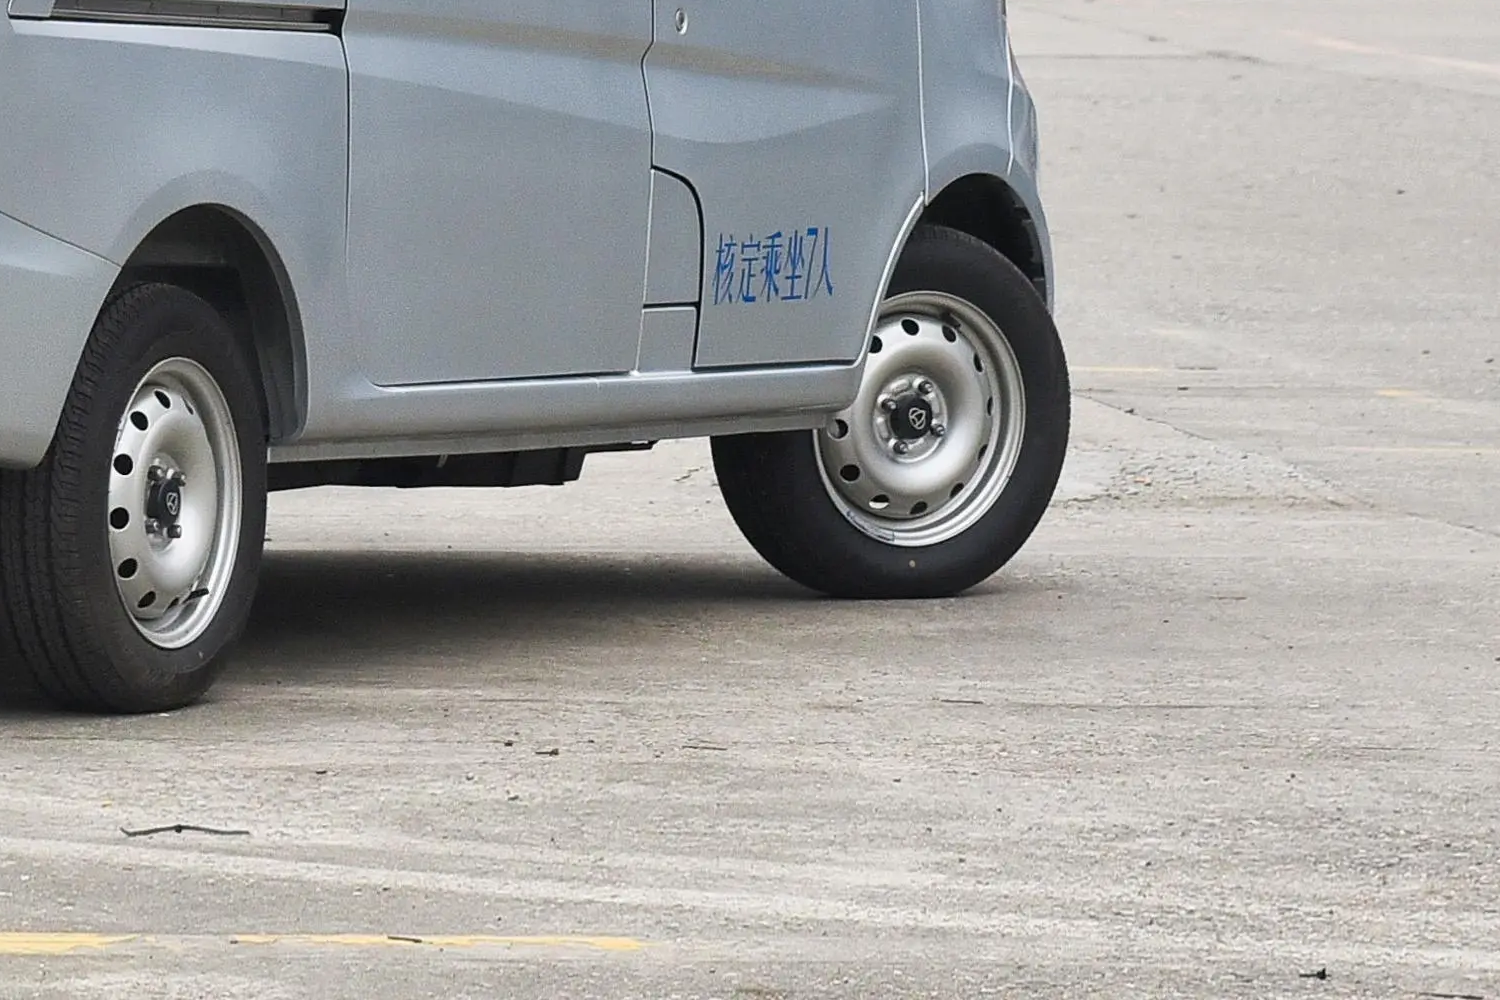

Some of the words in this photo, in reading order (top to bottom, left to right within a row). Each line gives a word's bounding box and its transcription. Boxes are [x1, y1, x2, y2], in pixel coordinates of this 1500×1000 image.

[712, 226, 834, 306] 核定乘坐7人
